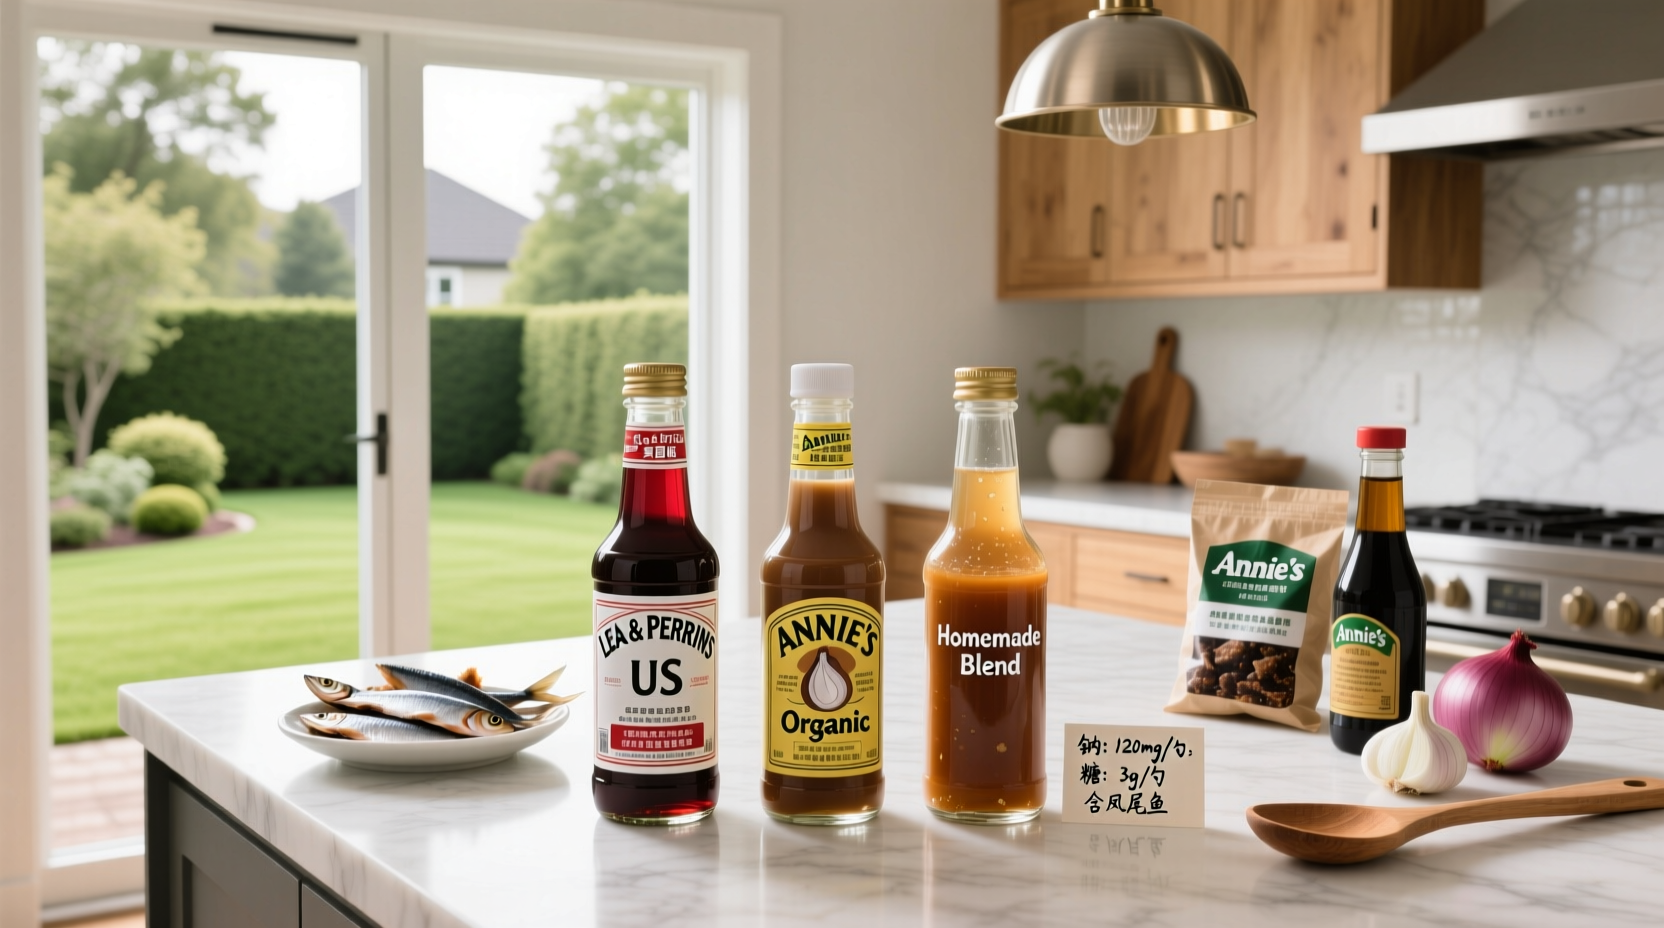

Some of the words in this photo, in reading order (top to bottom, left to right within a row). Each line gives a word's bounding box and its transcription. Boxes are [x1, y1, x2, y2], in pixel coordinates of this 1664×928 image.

[1211, 550, 1306, 582] Annie's
[598, 622, 629, 659] LEA
[628, 618, 644, 643] &
[646, 615, 716, 660] PERRINS
[777, 613, 878, 658] ANNIE'S
[937, 623, 1041, 648] Homemade
[1335, 623, 1387, 648] Annie's
[631, 658, 683, 696] US
[960, 652, 1021, 676] Blend
[781, 709, 871, 743] Organic
[1084, 790, 1168, 815] 含凤尾鱼
